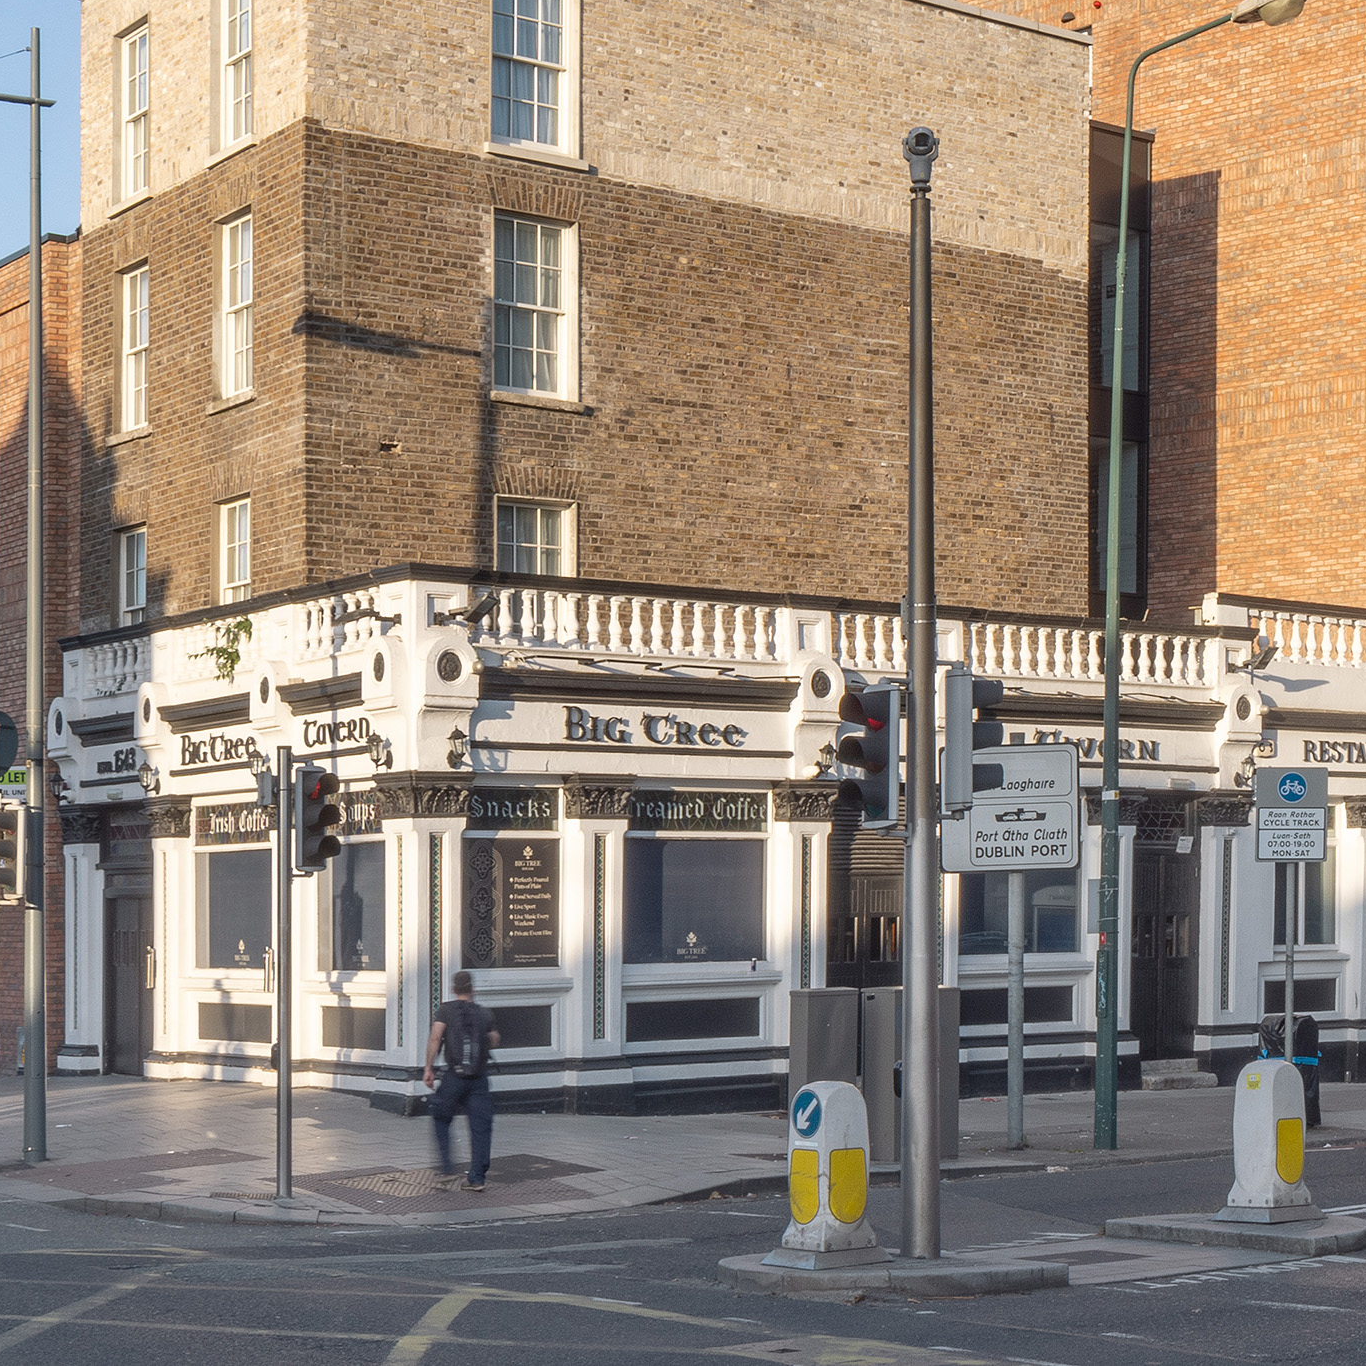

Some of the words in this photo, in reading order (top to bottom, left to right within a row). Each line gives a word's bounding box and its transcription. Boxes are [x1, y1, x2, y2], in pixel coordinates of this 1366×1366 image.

[8, 771, 26, 783] LET
[339, 801, 375, 829] Soups
[470, 794, 551, 818] Snacks
[712, 797, 766, 821] Coffee
[209, 811, 235, 835] Irish
[1263, 819, 1290, 827] CYCLE
[1293, 819, 1320, 827] TRACK
[975, 831, 997, 843] Port
[1034, 828, 1068, 840] Cliath
[975, 846, 1025, 858] DUBLIN
[1031, 844, 1067, 856] PORT
